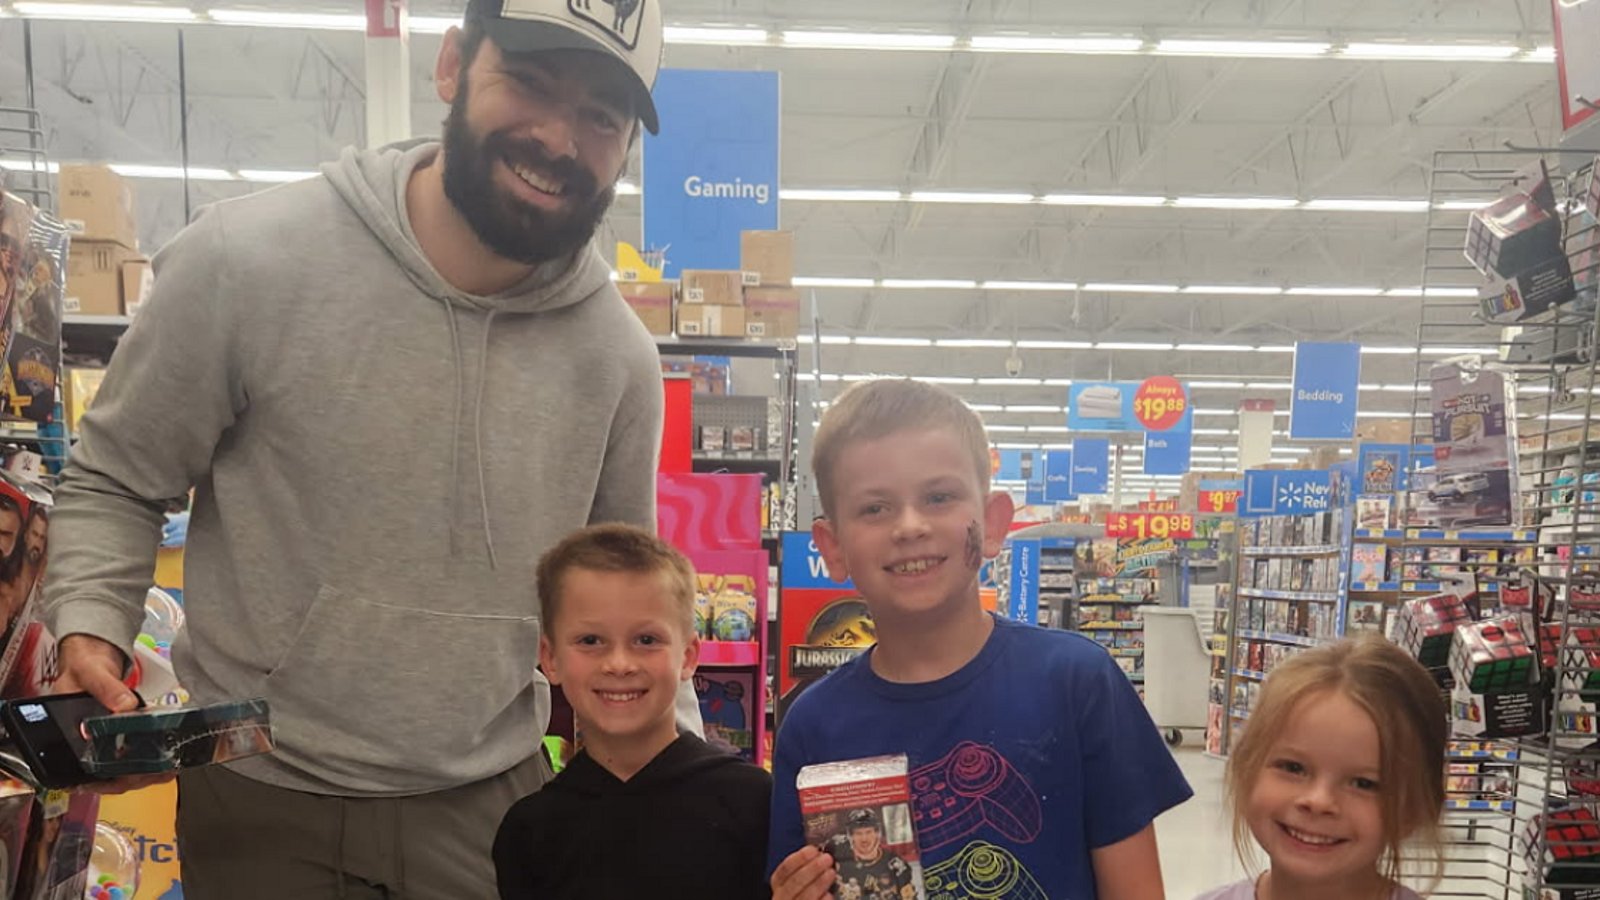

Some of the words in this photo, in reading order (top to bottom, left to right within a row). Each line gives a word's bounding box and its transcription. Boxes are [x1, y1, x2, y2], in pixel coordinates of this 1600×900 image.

[684, 175, 769, 204] Gaming
[1145, 386, 1177, 397] Always
[1298, 389, 1343, 404] Bedding
[1148, 439, 1167, 448] Bath
